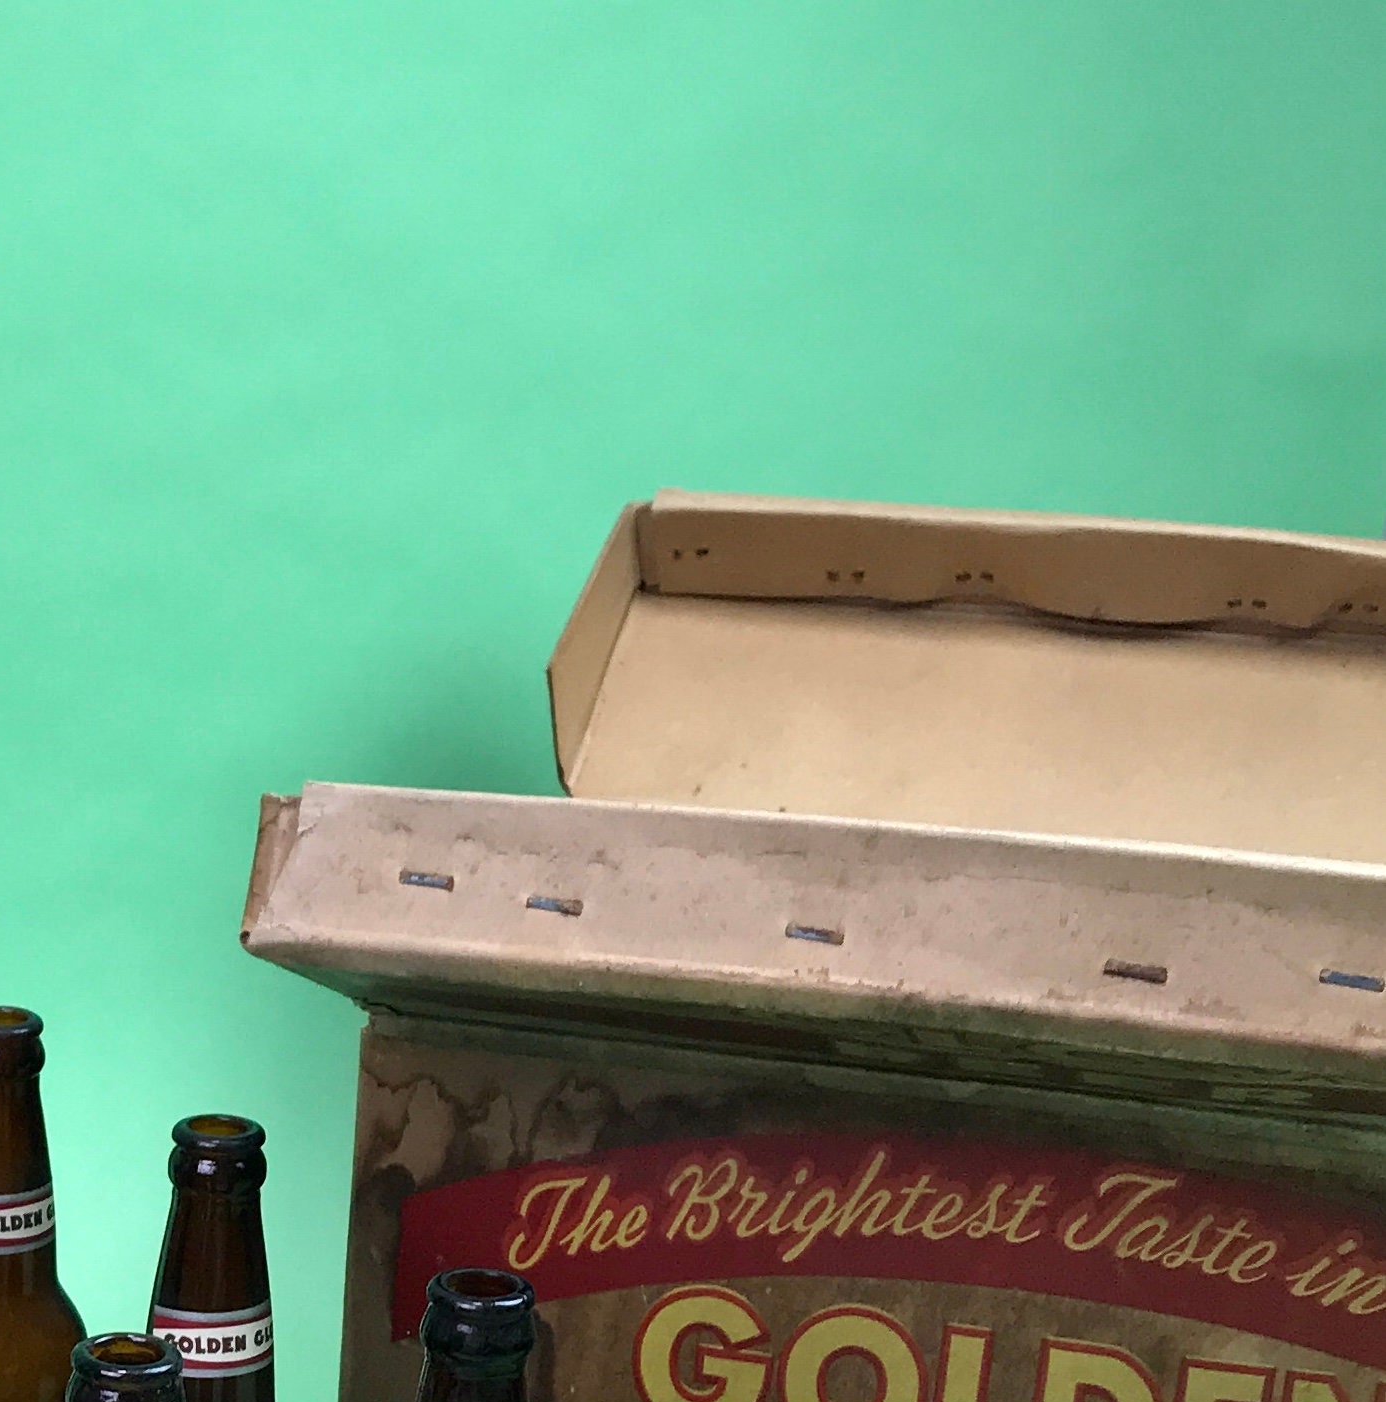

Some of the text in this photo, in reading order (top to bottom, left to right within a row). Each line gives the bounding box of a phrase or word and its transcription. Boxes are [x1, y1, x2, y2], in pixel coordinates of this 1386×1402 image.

[508, 1151, 1386, 1315] The Brightest Taste in
